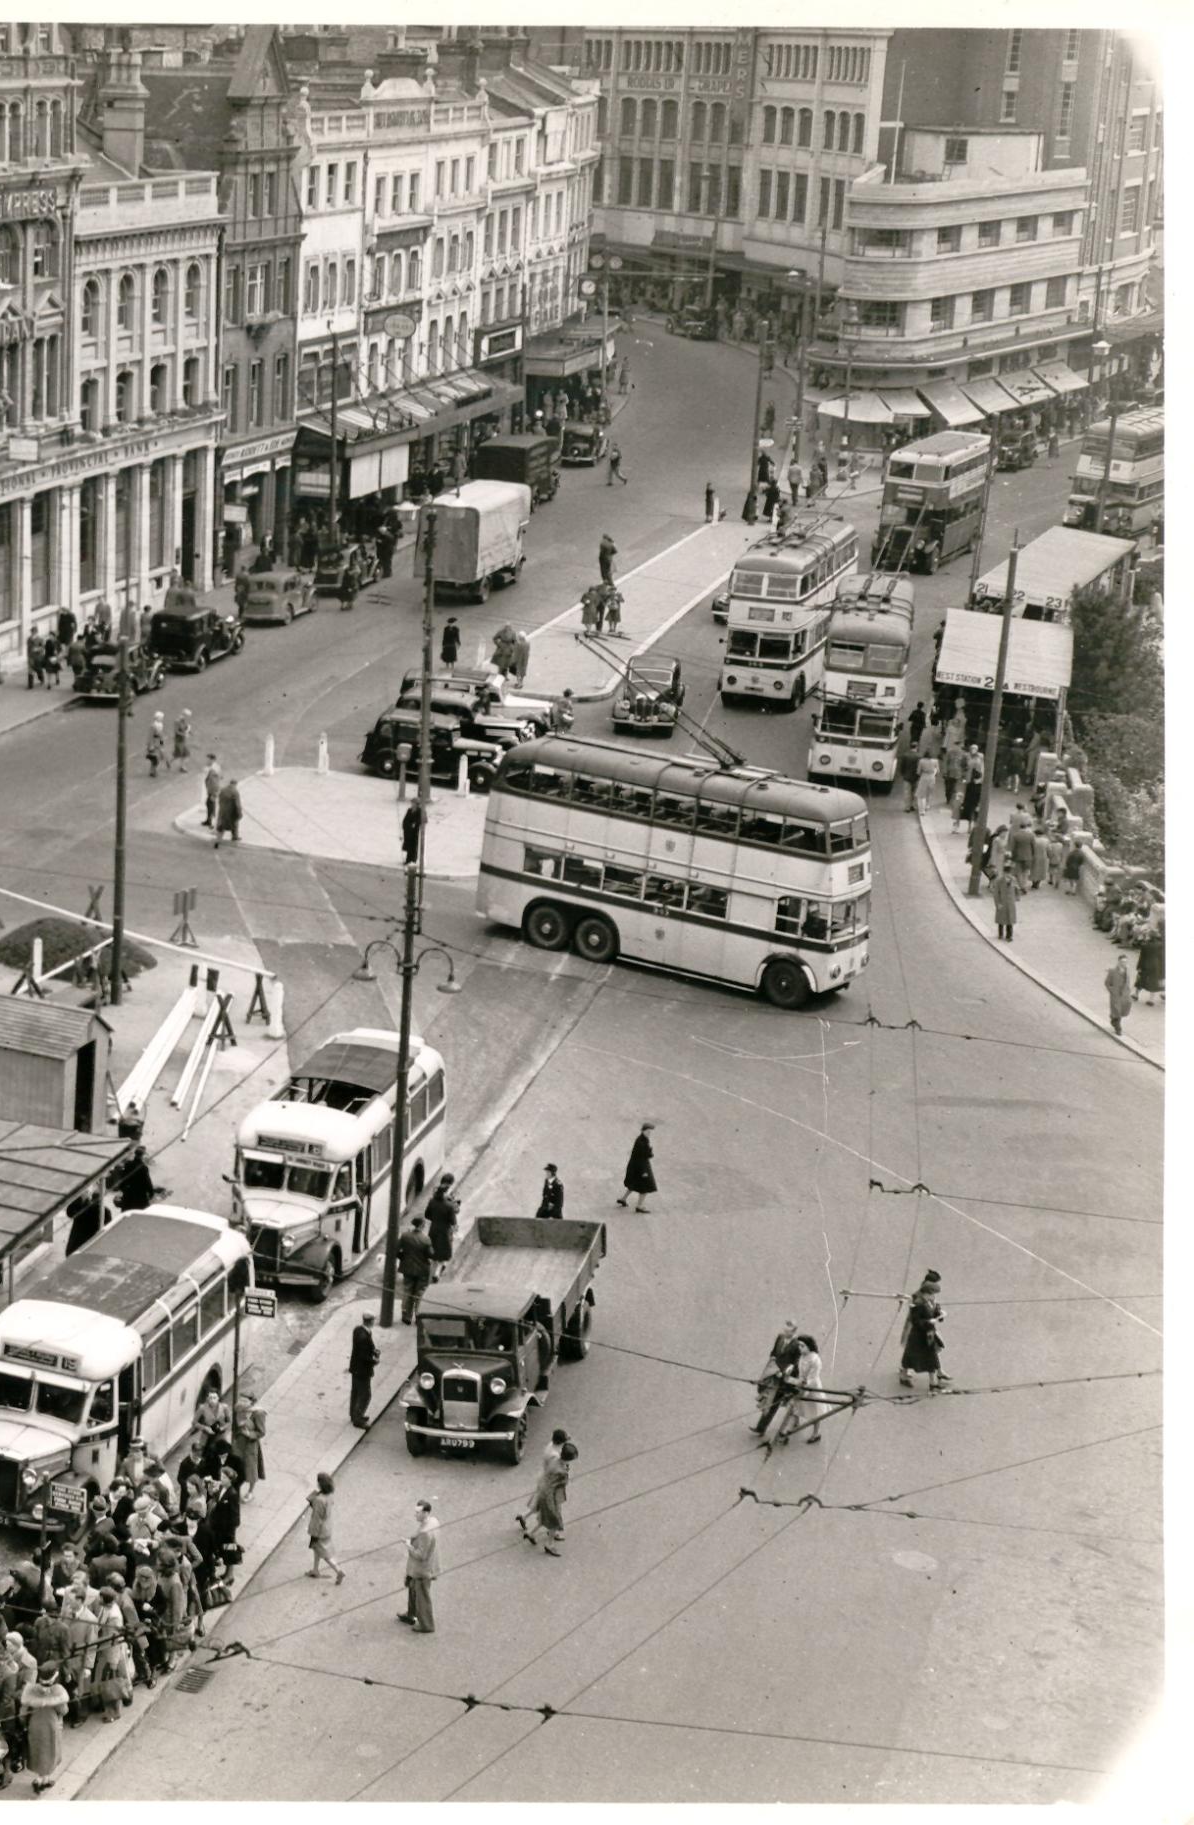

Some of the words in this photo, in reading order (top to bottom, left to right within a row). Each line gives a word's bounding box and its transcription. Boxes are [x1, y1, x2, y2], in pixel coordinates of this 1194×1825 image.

[51, 451, 109, 479] PROVINCIAL
[123, 442, 150, 459] BANK
[976, 583, 989, 594] 21
[1045, 596, 1063, 608] 23
[956, 672, 982, 684] STATION
[1013, 682, 1058, 696] WESTBOURNE
